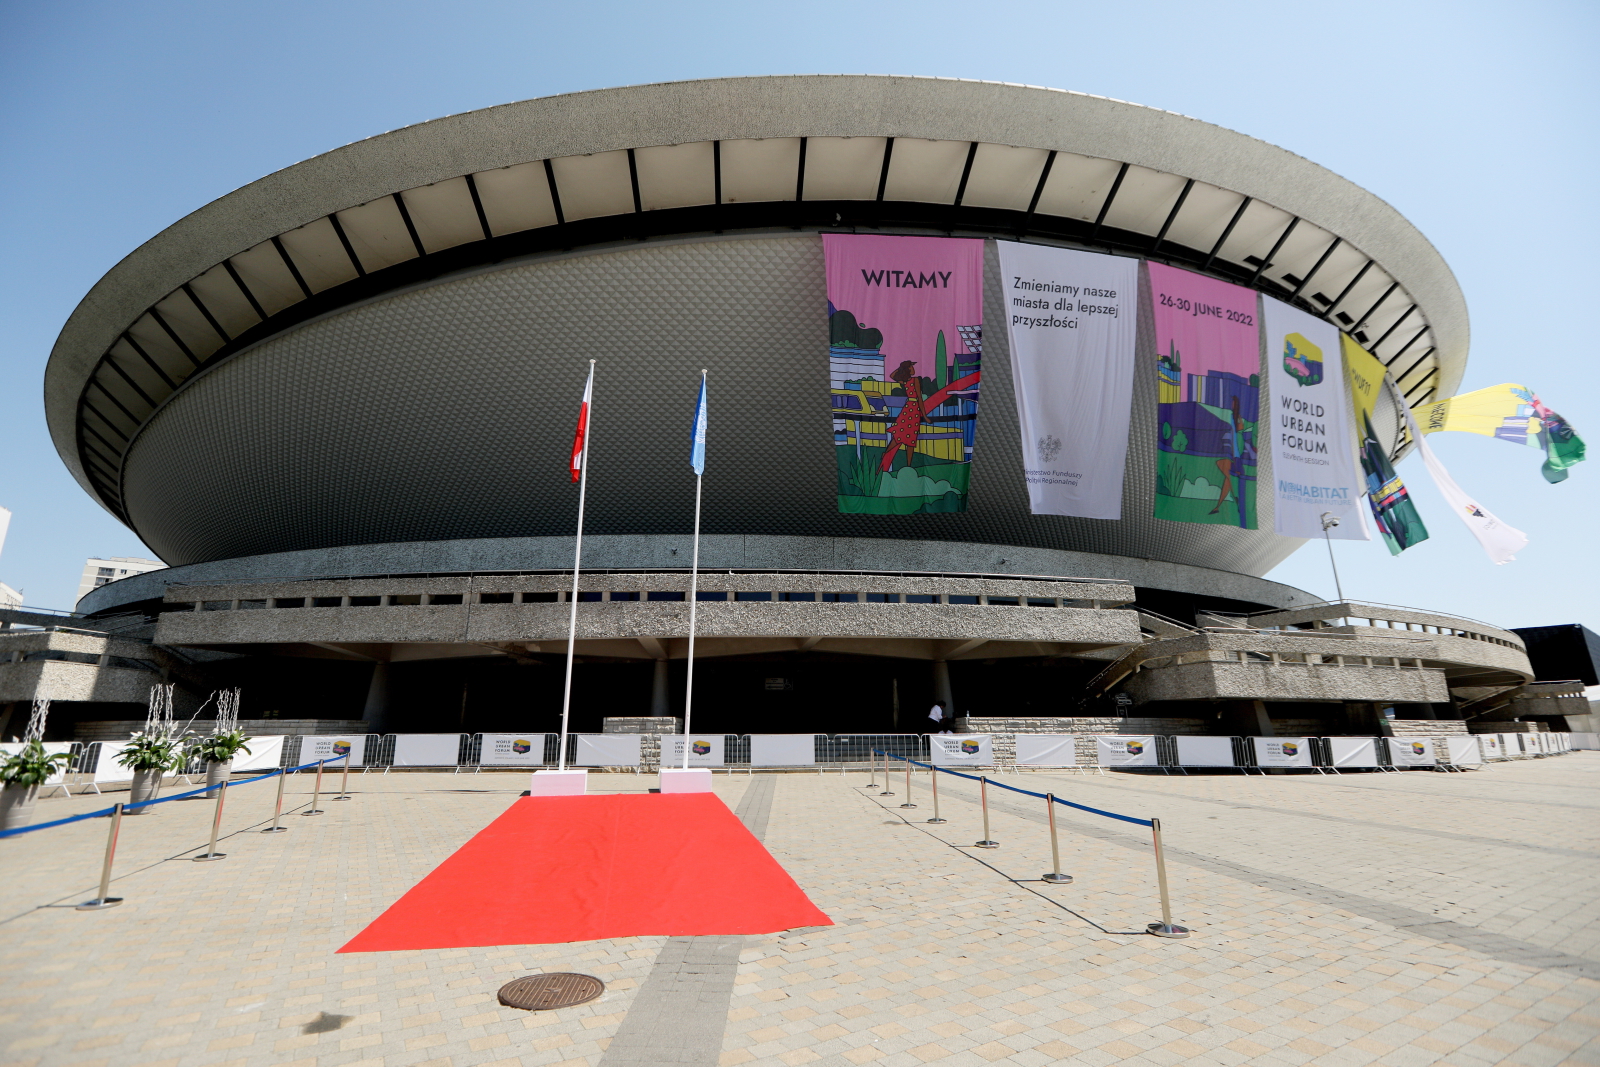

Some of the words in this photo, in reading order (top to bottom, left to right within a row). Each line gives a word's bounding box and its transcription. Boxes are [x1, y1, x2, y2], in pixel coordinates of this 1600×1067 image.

[861, 269, 952, 288] WITAMY
[1014, 276, 1079, 297] Zmieniamy
[1083, 287, 1117, 298] nasze
[1013, 296, 1049, 309] miasta
[1054, 298, 1073, 311] dla
[1077, 300, 1118, 318] lepszej
[1160, 293, 1190, 311] 26-30
[1192, 302, 1223, 318] JUNE
[1226, 309, 1253, 326] 2022
[1012, 314, 1078, 329] przyszłości
[1281, 395, 1325, 417] WORLD
[1281, 414, 1325, 436] URBAN
[1282, 433, 1328, 454] FORUM
[1042, 477, 1078, 486] Regionalnej
[1052, 470, 1083, 479] Funduszy
